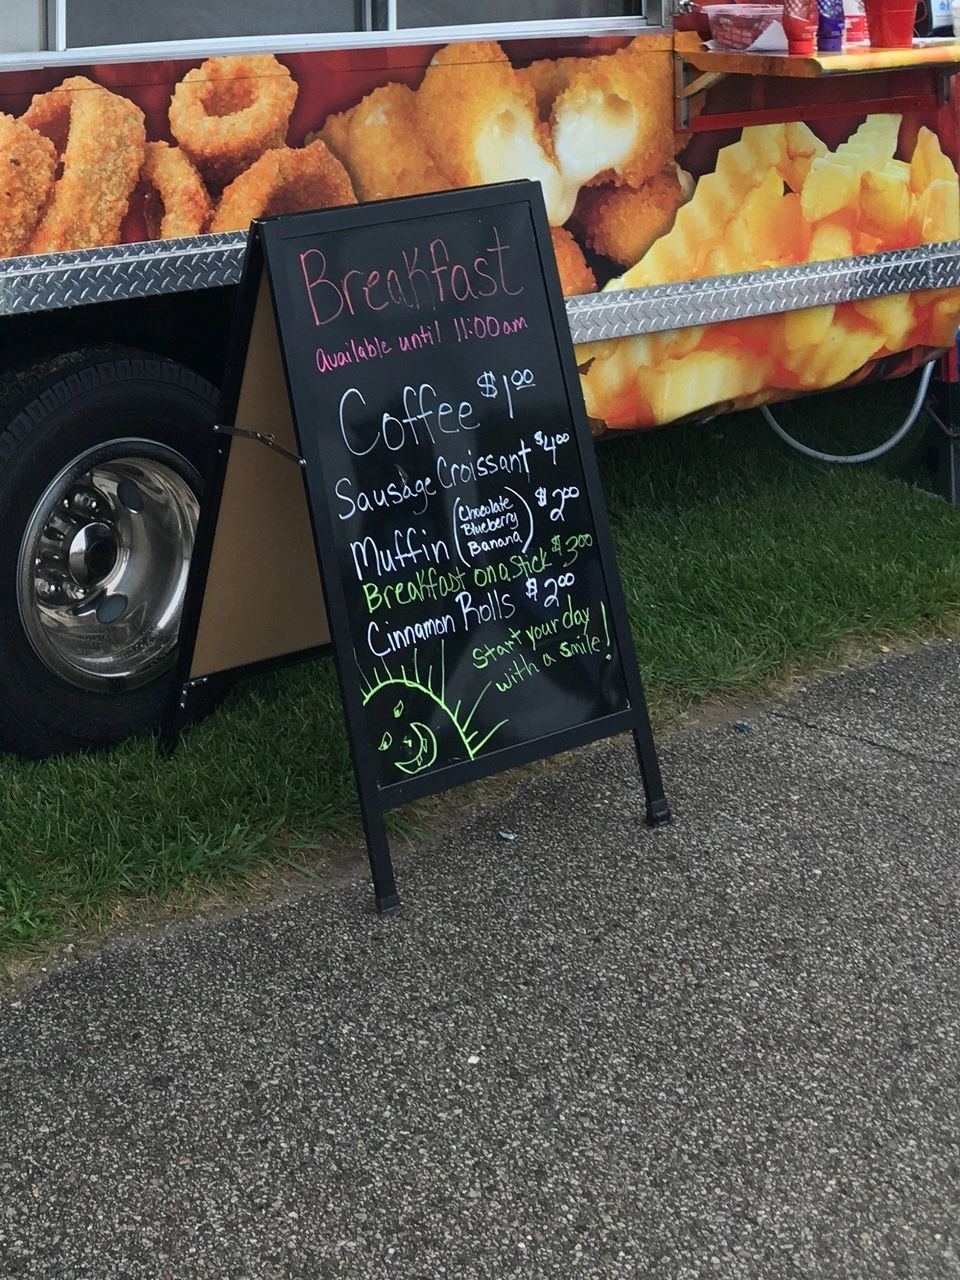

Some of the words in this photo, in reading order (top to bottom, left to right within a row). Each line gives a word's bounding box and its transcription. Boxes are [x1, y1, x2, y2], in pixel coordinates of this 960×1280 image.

[300, 228, 524, 326] Breakfast
[316, 336, 392, 373] available
[399, 321, 441, 352] until
[339, 382, 481, 456] Coffee
[335, 474, 437, 520] Sausage
[437, 439, 532, 488] Croissant
[349, 527, 450, 581] Muffin
[461, 512, 519, 536] Blueberry
[363, 567, 466, 613] Breakfast
[368, 614, 456, 657] Cinnamon
[455, 591, 516, 631] Rolls
[472, 627, 522, 669] Start
[526, 618, 559, 651] your
[562, 594, 590, 635] day
[496, 653, 540, 693] with
[543, 653, 556, 667] a
